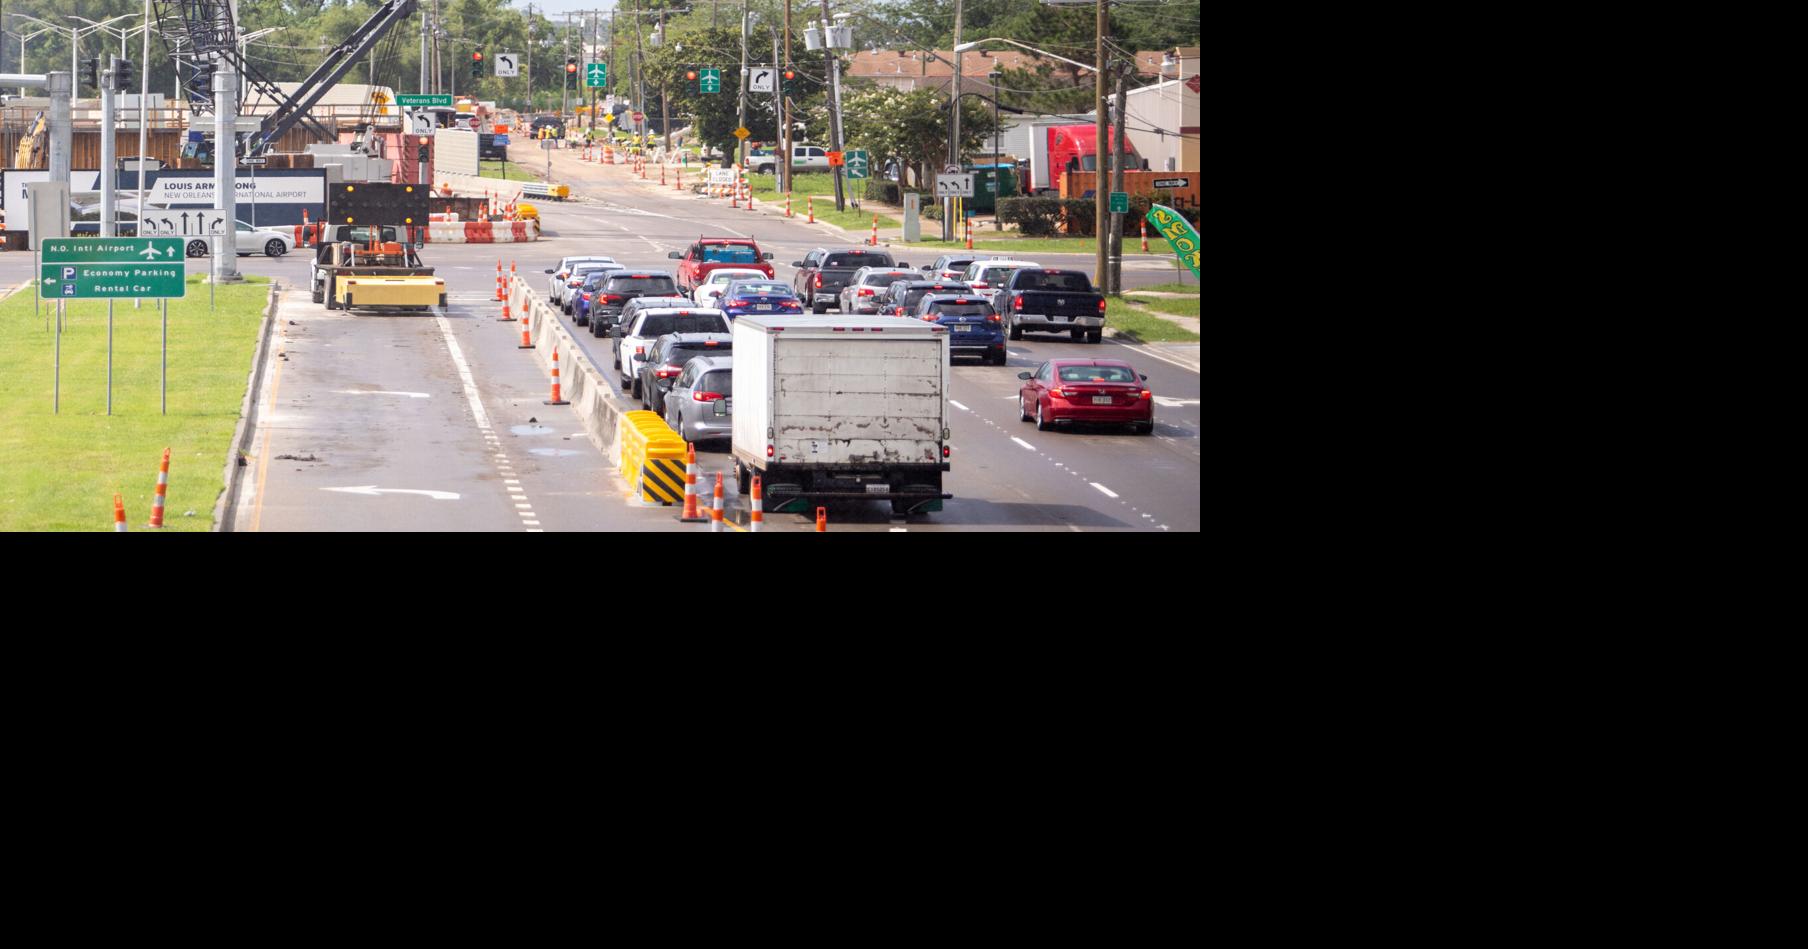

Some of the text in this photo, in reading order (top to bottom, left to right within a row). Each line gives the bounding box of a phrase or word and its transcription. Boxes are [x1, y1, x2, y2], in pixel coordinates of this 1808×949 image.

[97, 245, 135, 253] Airport
[83, 269, 176, 278] Economy Parking
